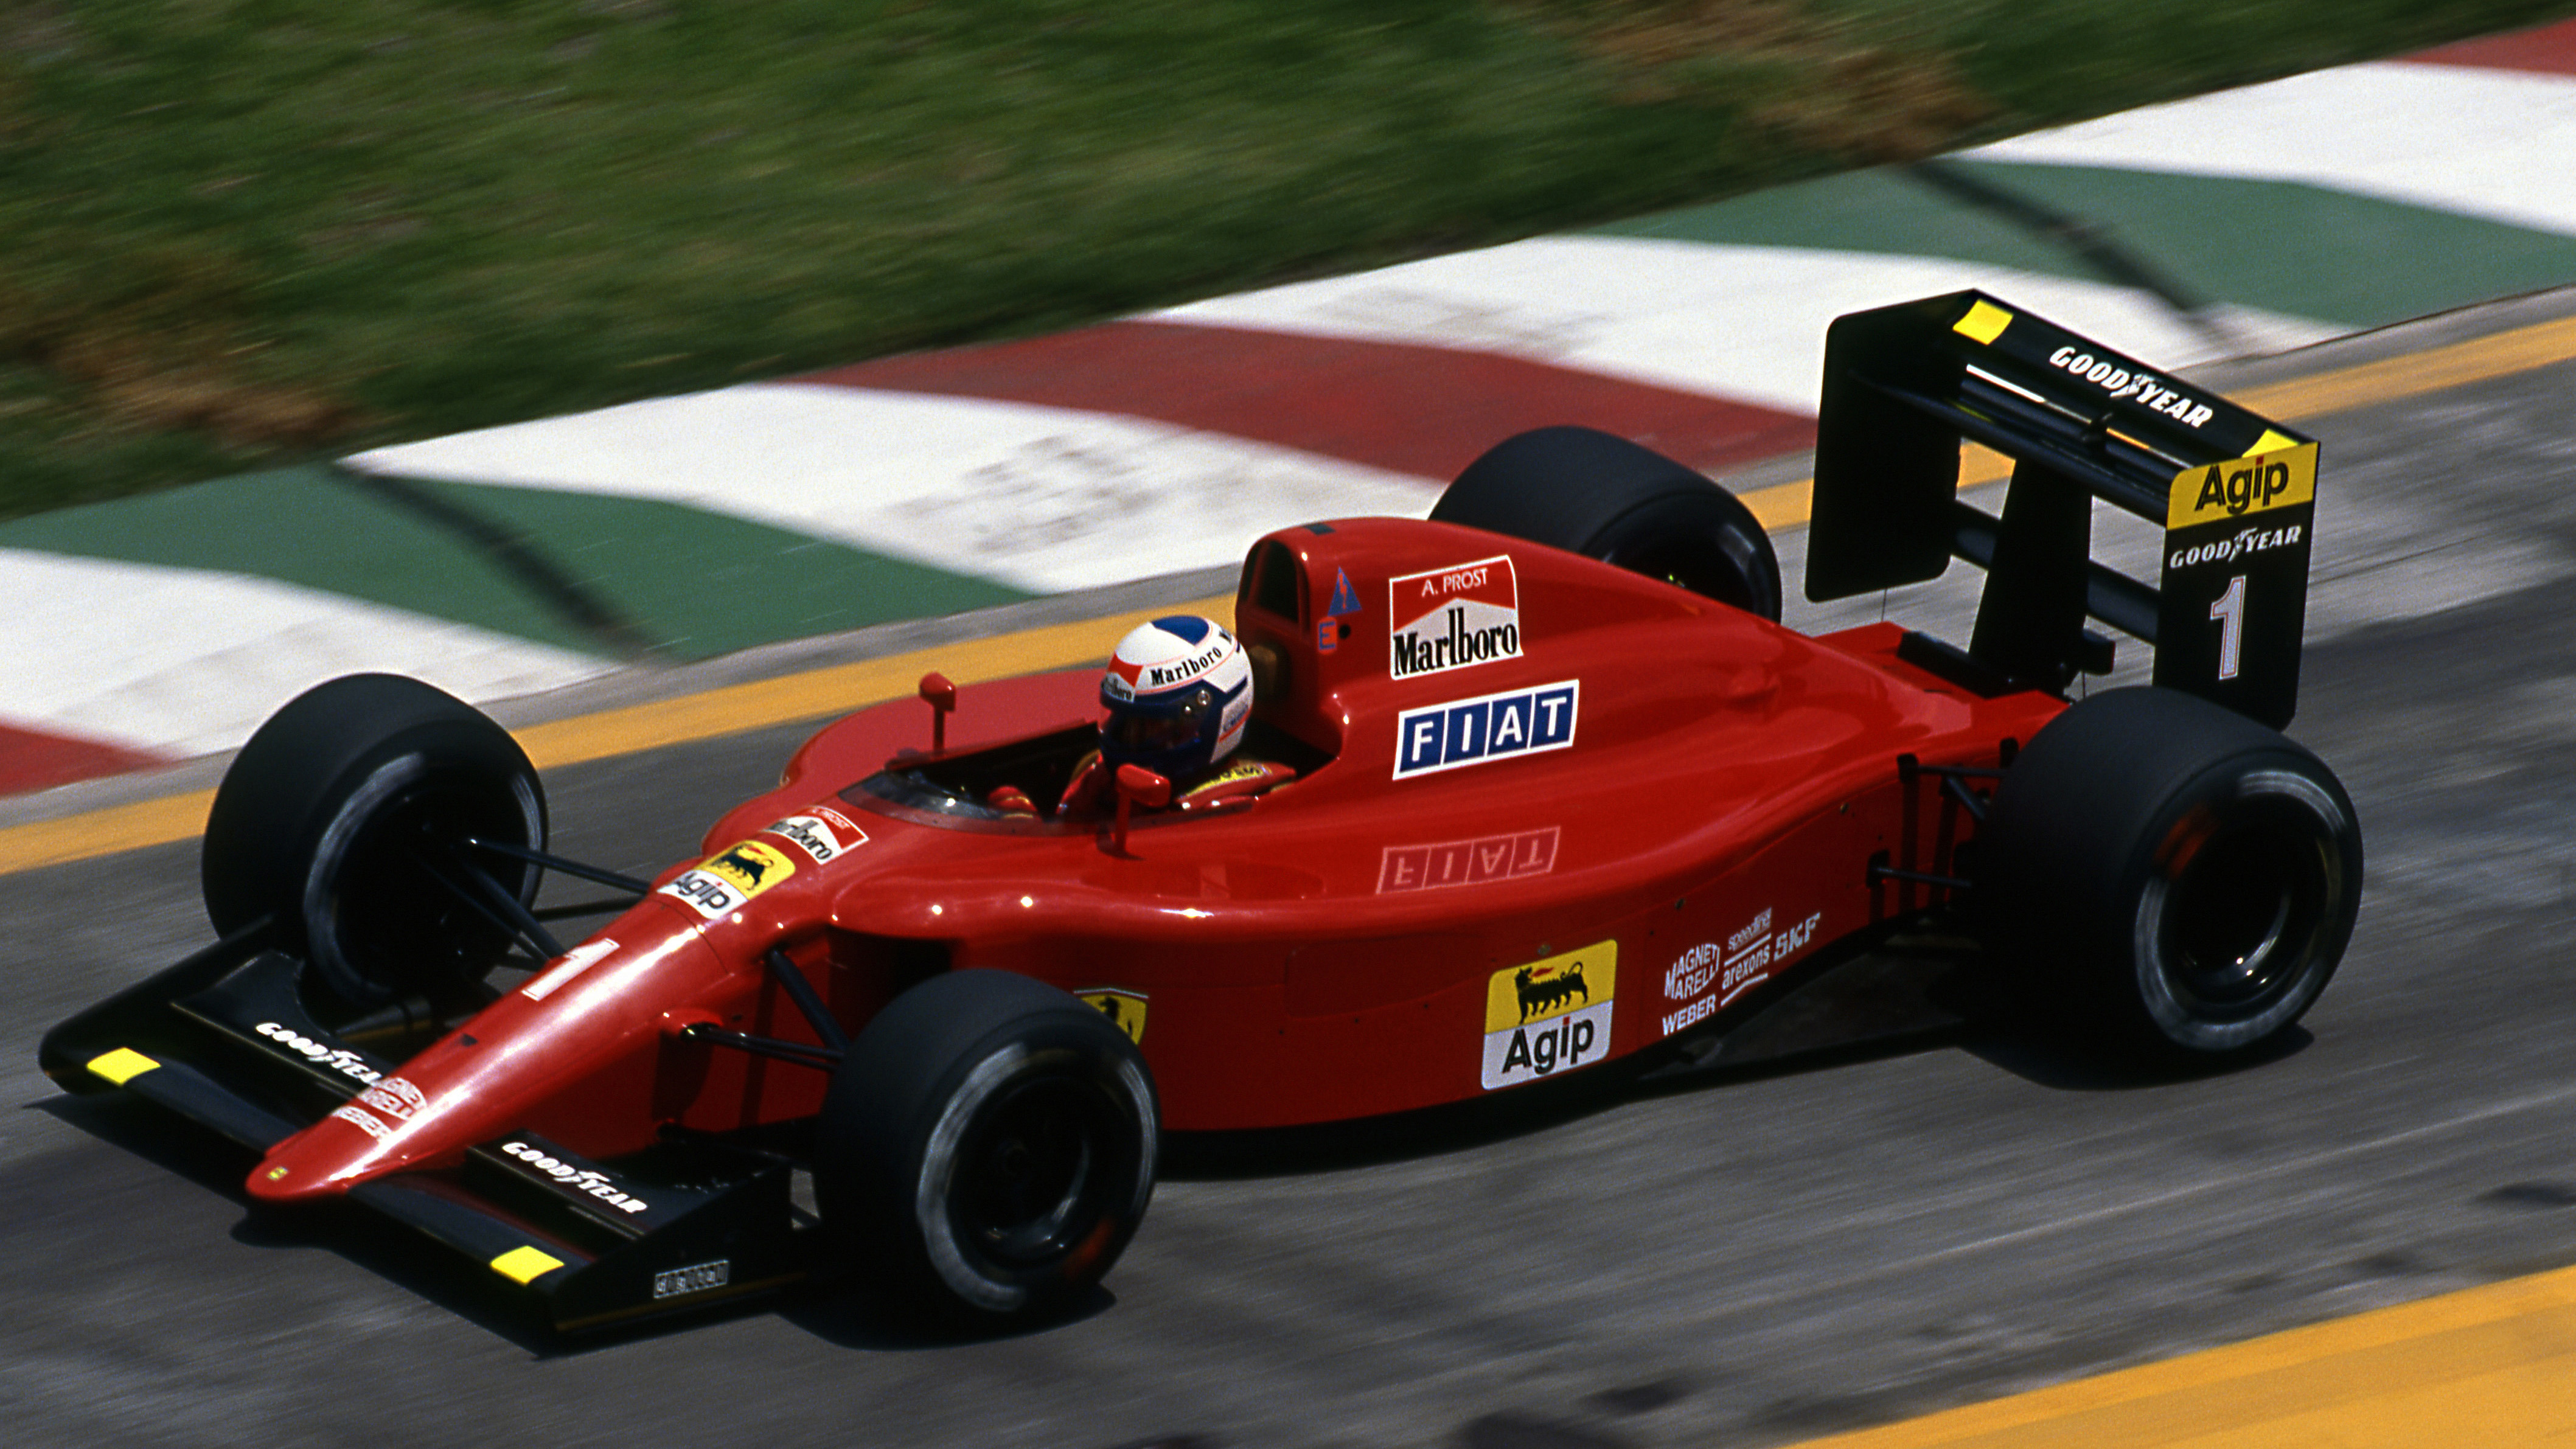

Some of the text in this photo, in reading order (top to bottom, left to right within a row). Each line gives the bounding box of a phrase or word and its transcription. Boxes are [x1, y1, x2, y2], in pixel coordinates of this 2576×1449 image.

[2049, 346, 2213, 428] GOODYEAR
[2195, 456, 2289, 515] Agip
[2170, 525, 2302, 568] GOODYEAR
[1421, 569, 1488, 597] A. PROST
[1318, 620, 1336, 650] E
[1393, 606, 1518, 676] Marlboro
[2210, 575, 2246, 681] 1
[1150, 646, 1223, 687] Marlboro
[1411, 697, 1567, 762] FIAT
[1773, 911, 1821, 962] SKF
[521, 937, 621, 1002] 1
[1722, 944, 1770, 990] arexons
[1662, 993, 1716, 1036] WEBER
[256, 1022, 383, 1084] GOODYEA
[1502, 1016, 1594, 1074] Agip
[502, 1142, 648, 1214] GOODYEAR
